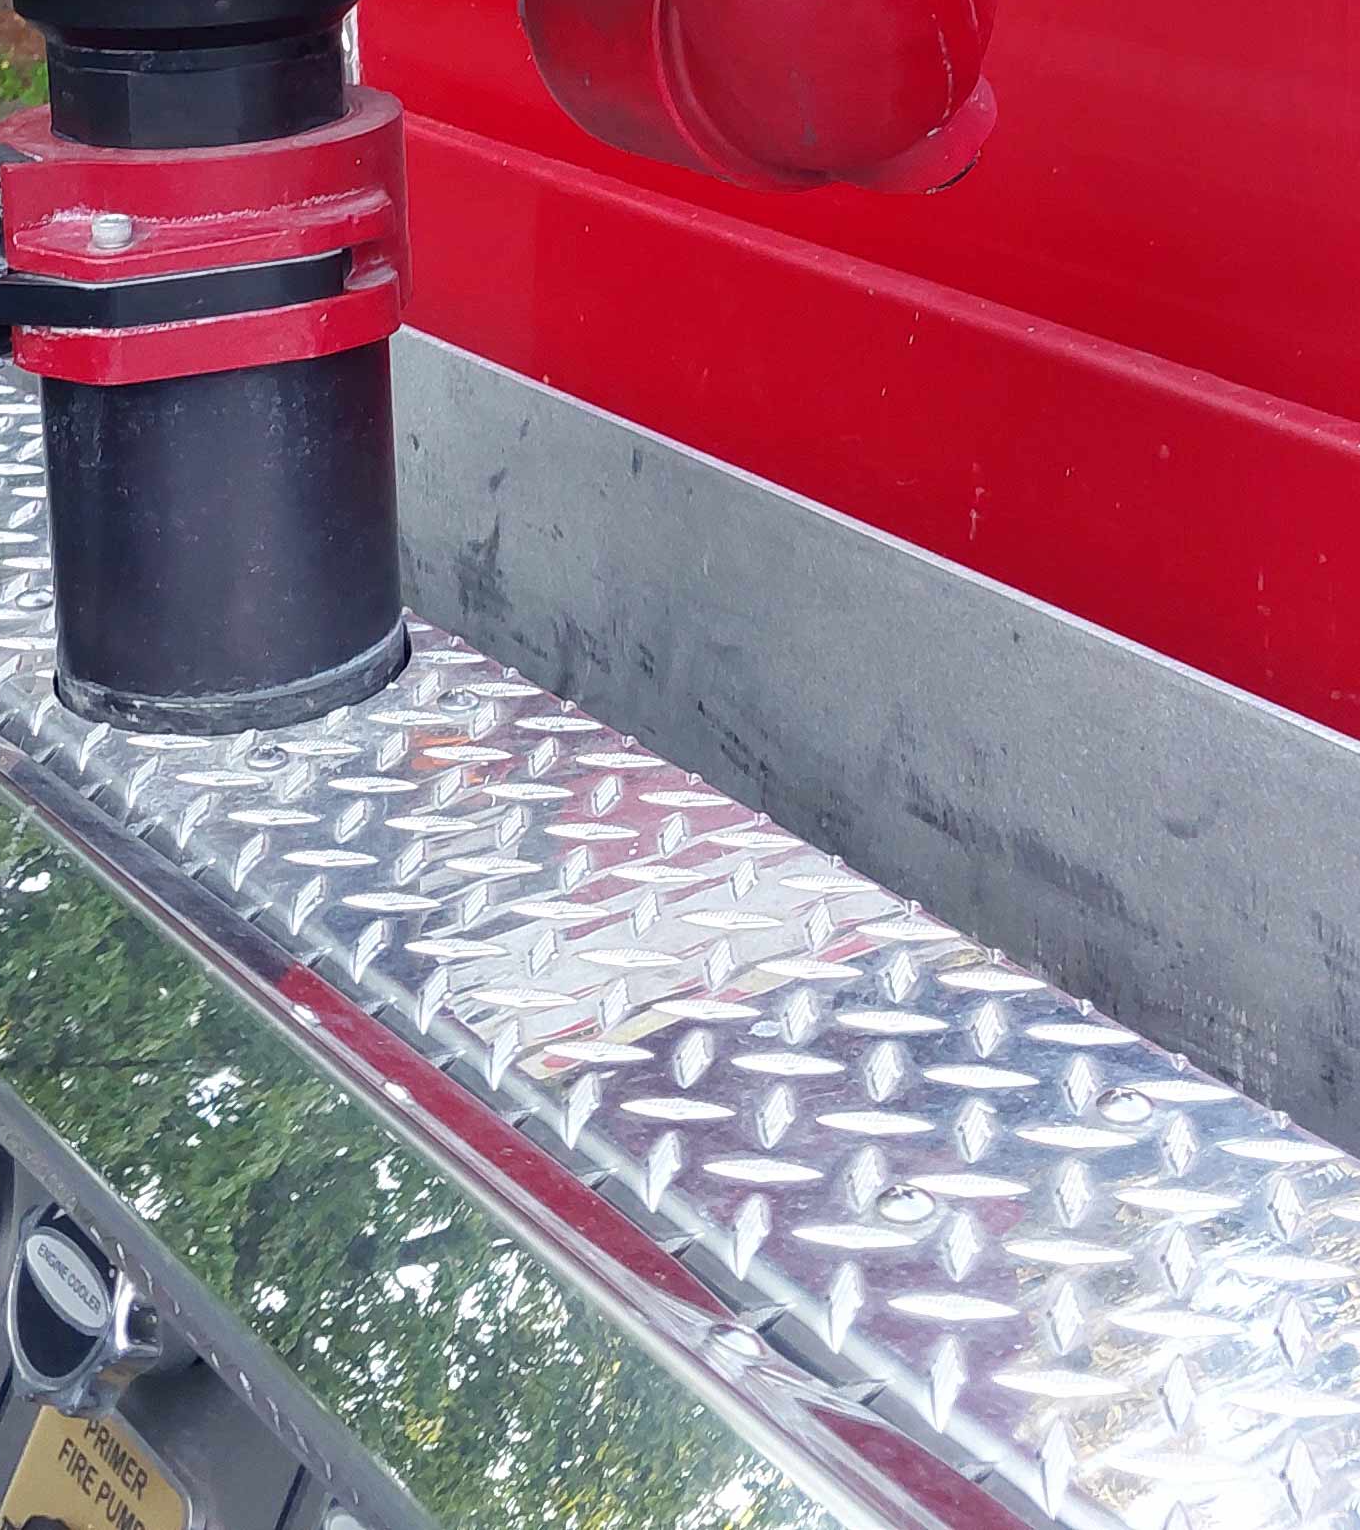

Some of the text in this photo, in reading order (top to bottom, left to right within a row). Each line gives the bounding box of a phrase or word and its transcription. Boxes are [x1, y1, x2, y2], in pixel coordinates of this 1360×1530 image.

[38, 1243, 102, 1316] ENGINE COOLER
[58, 1438, 99, 1496] FIRE
[84, 1419, 149, 1501] PRIMER
